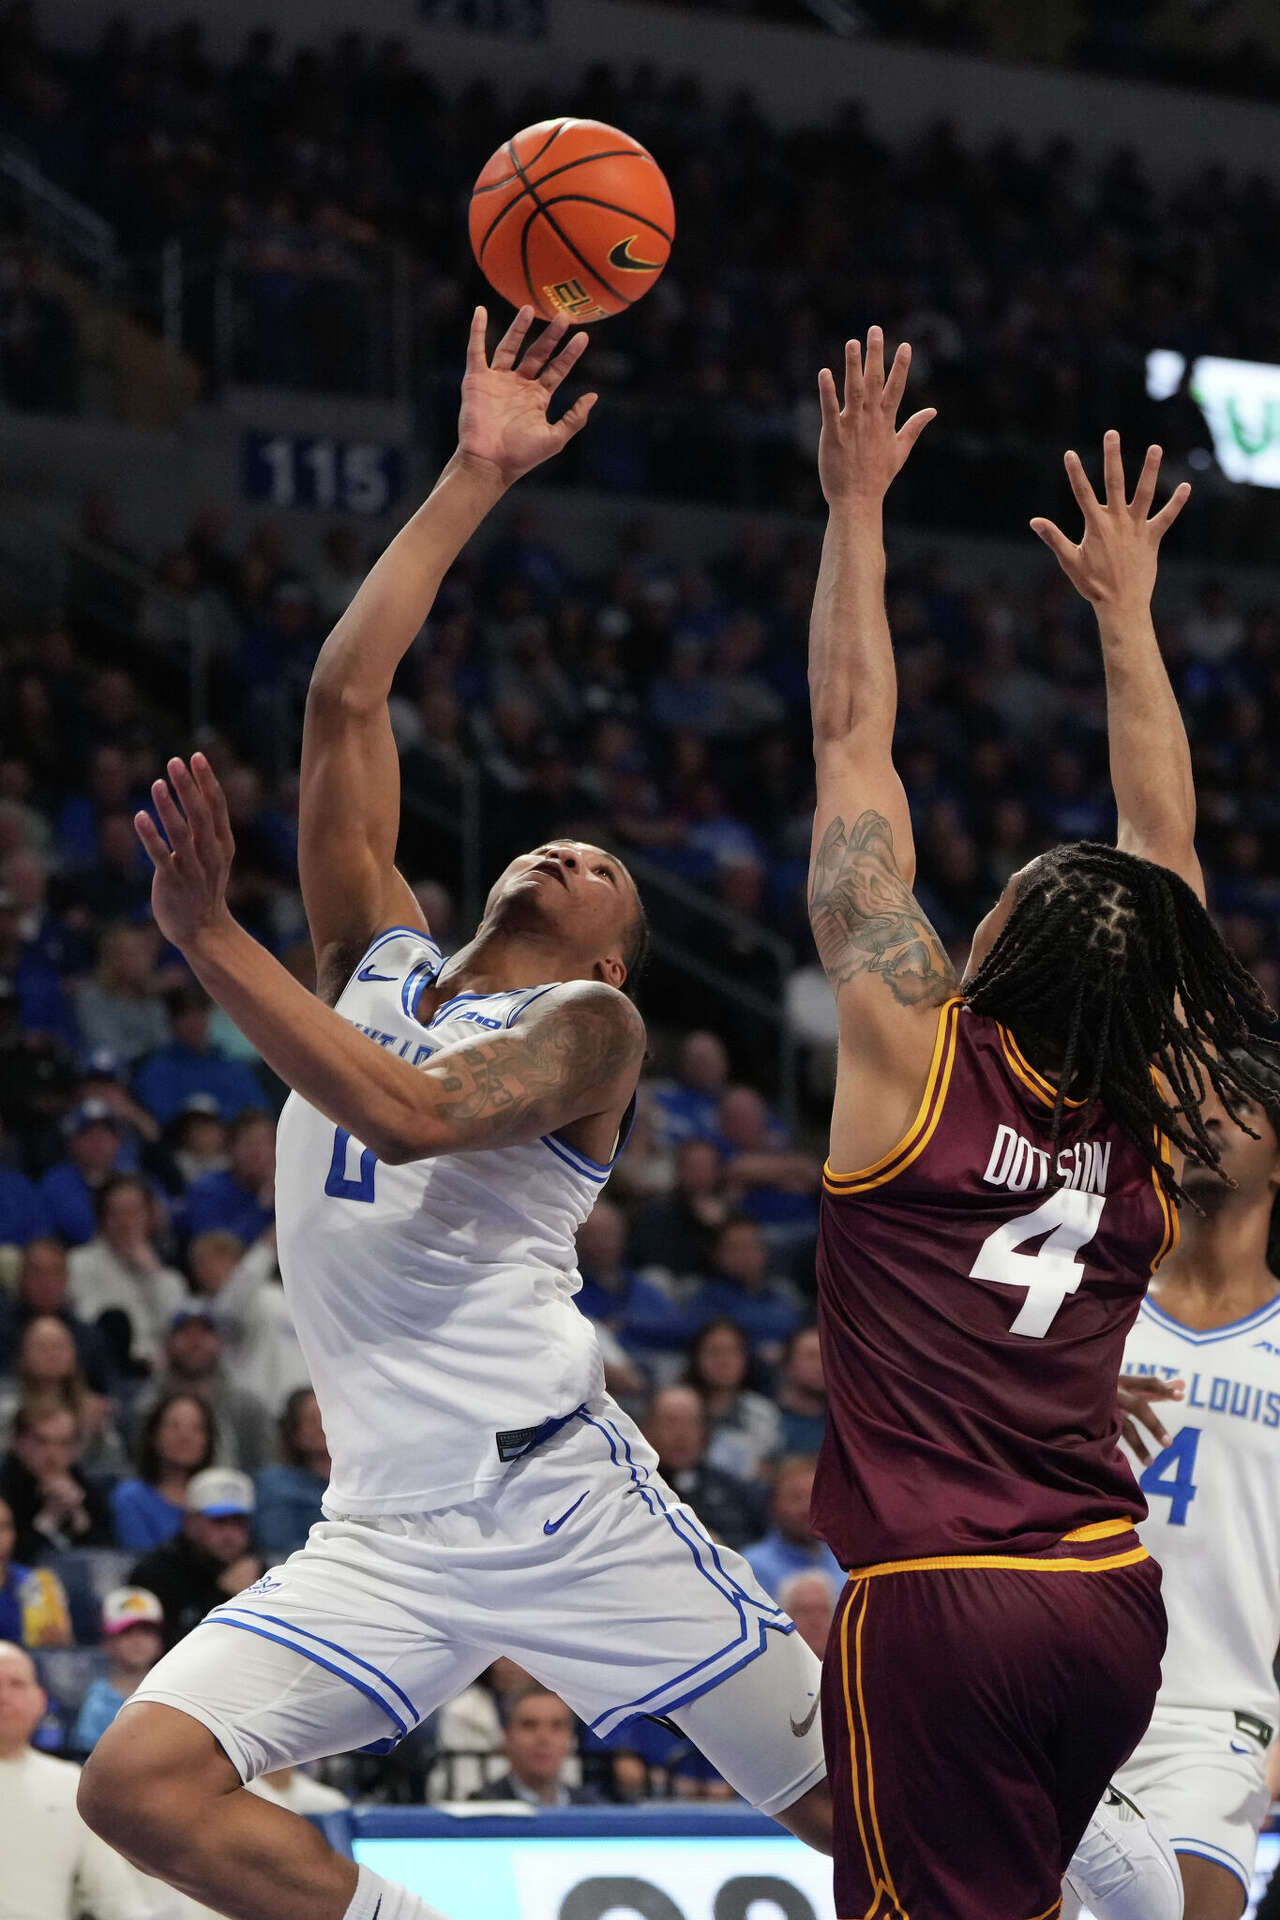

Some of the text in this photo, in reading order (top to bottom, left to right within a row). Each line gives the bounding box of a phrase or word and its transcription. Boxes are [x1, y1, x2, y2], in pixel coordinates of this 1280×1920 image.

[258, 437, 389, 514] 115
[983, 1124, 1112, 1193] DOTSON
[969, 1187, 1106, 1339] 4
[1188, 1372, 1280, 1429] LOUIS
[1139, 1426, 1202, 1526] 4
